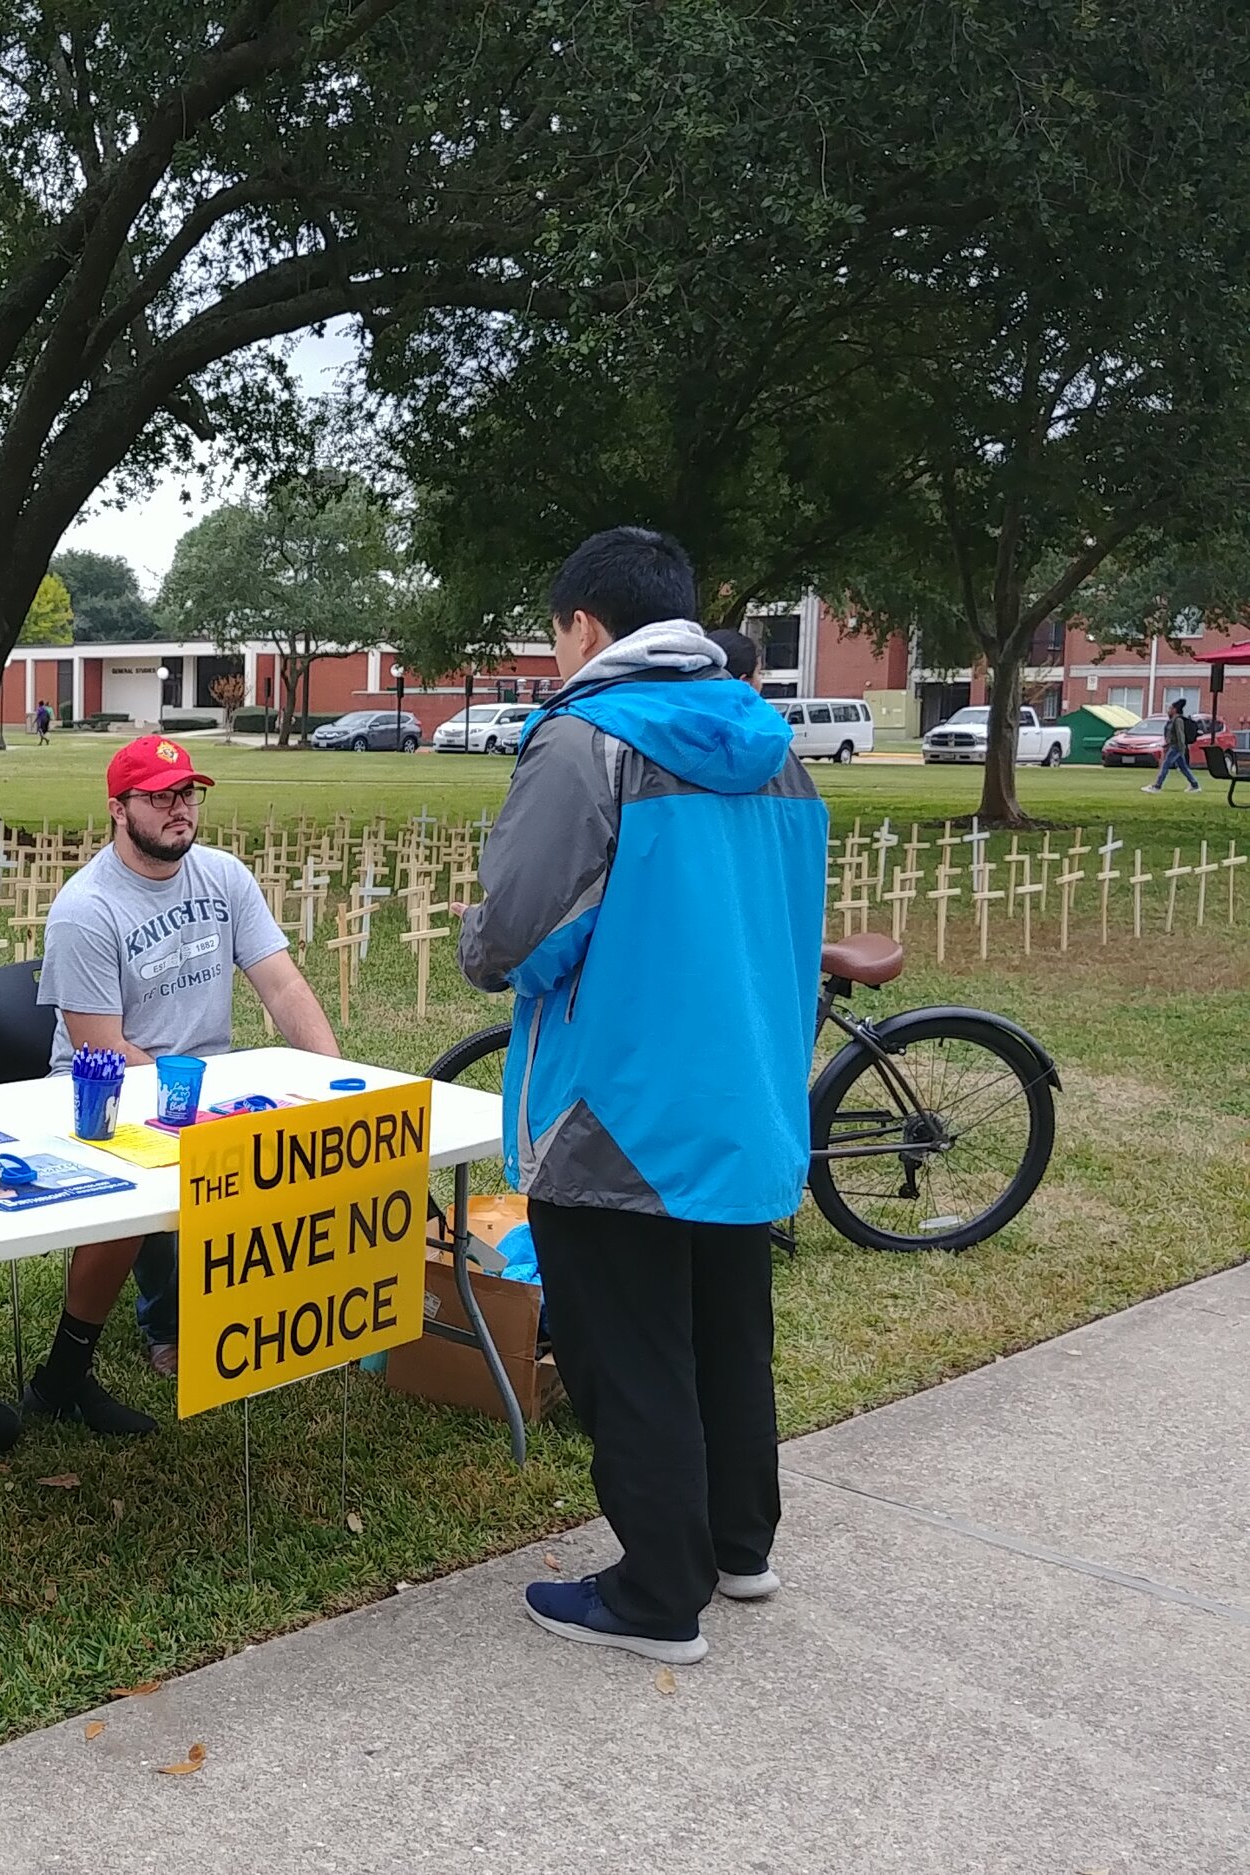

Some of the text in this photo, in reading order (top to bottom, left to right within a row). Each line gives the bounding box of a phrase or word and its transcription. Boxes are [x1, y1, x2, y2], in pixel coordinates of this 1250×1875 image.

[124, 897, 230, 963] KNIGHTS
[153, 939, 216, 974] EST 1882
[160, 962, 222, 997] CUMBS
[190, 1106, 426, 1206] THE UNBORN
[203, 1190, 412, 1296] HAVE NO
[216, 1273, 399, 1380] CHOICE
